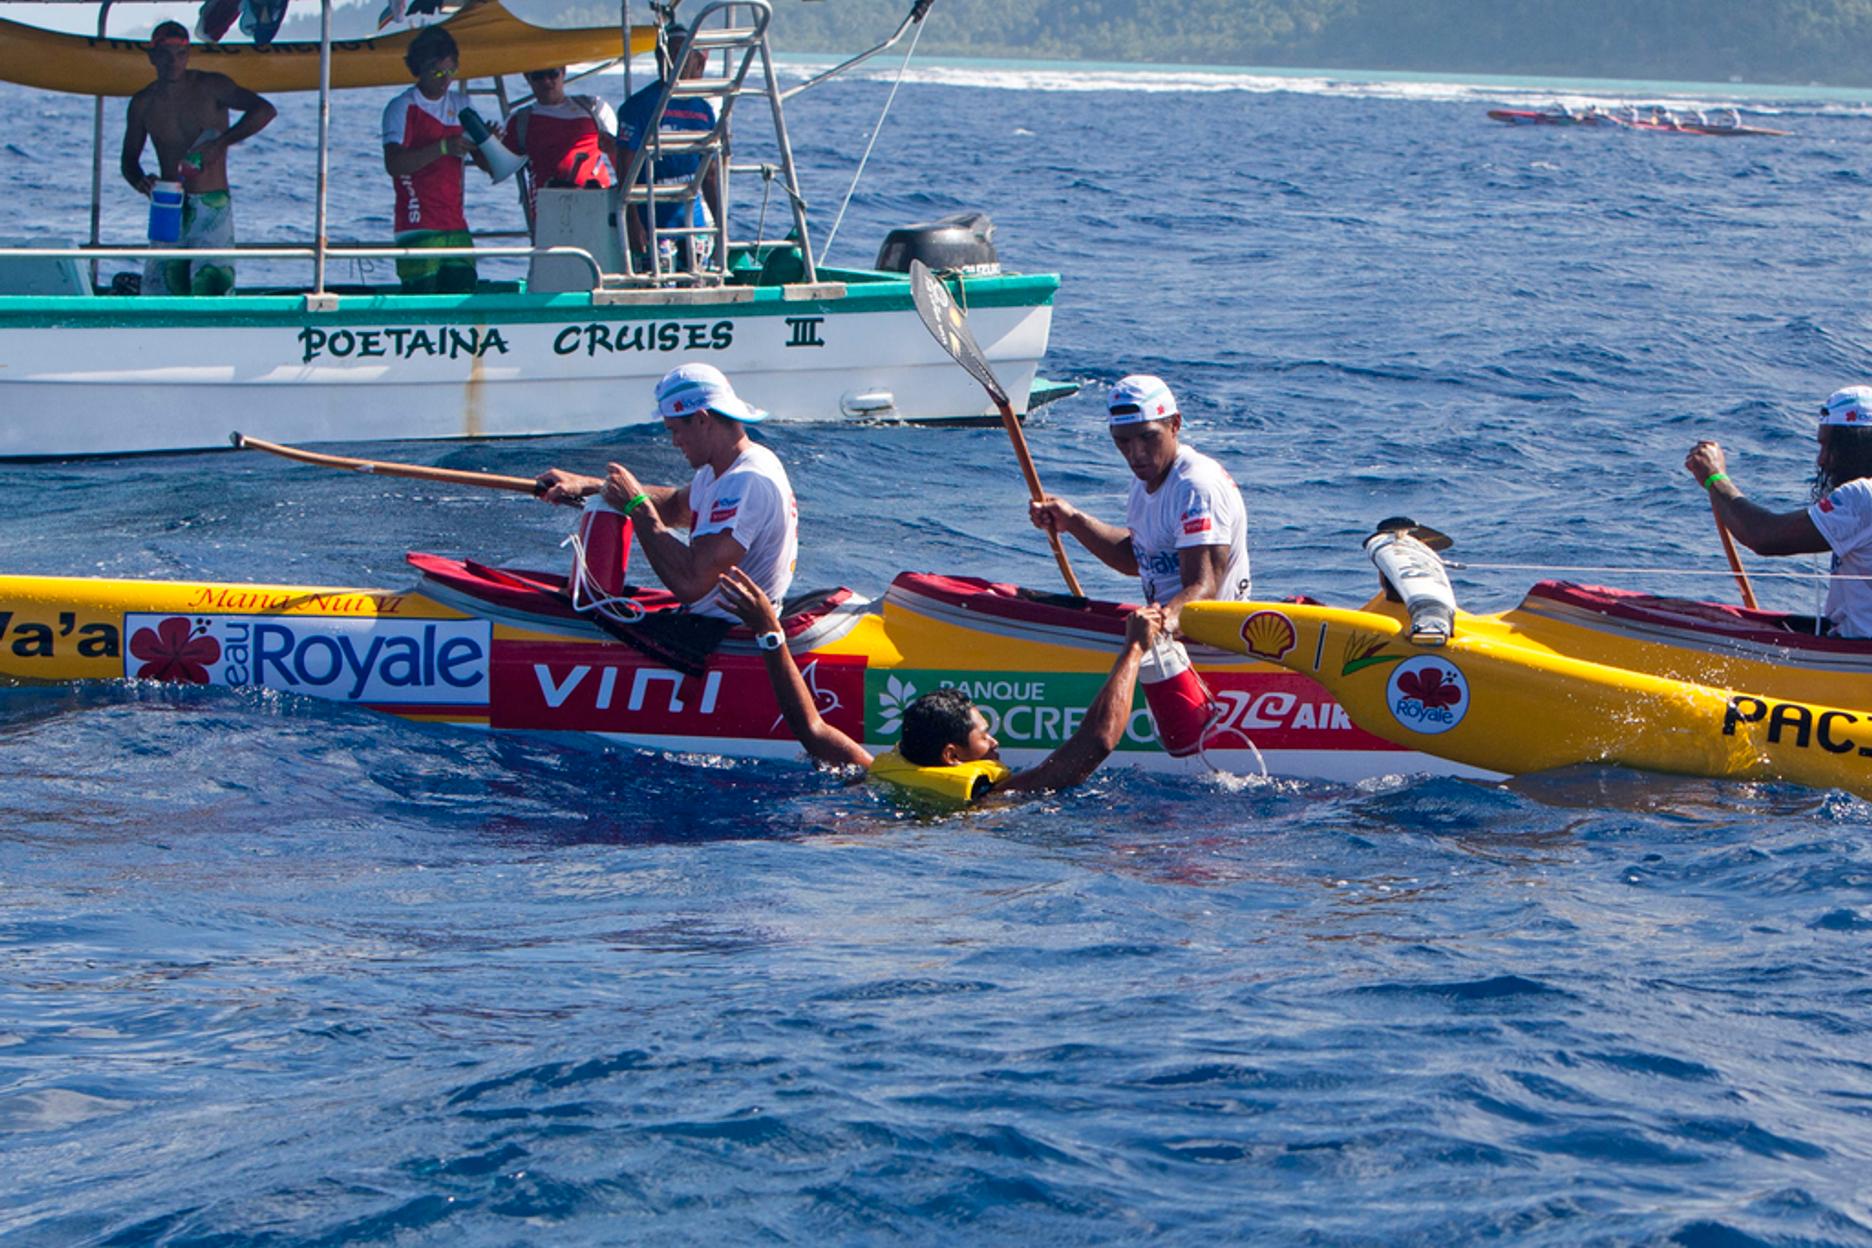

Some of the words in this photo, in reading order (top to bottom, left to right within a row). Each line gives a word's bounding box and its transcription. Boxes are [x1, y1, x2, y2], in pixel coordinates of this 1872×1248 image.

[298, 326, 509, 364] POETAINA
[553, 320, 734, 357] CRUISES
[785, 316, 825, 347] III
[188, 588, 290, 612] Mana
[295, 593, 368, 612] Nui
[0, 612, 120, 657] a'a
[224, 622, 250, 687] eau
[253, 623, 485, 698] Royale
[940, 680, 1046, 700] BANQUE
[1396, 699, 1456, 725] Royale
[1291, 703, 1352, 729] AIR
[1722, 695, 1872, 758] PAC
